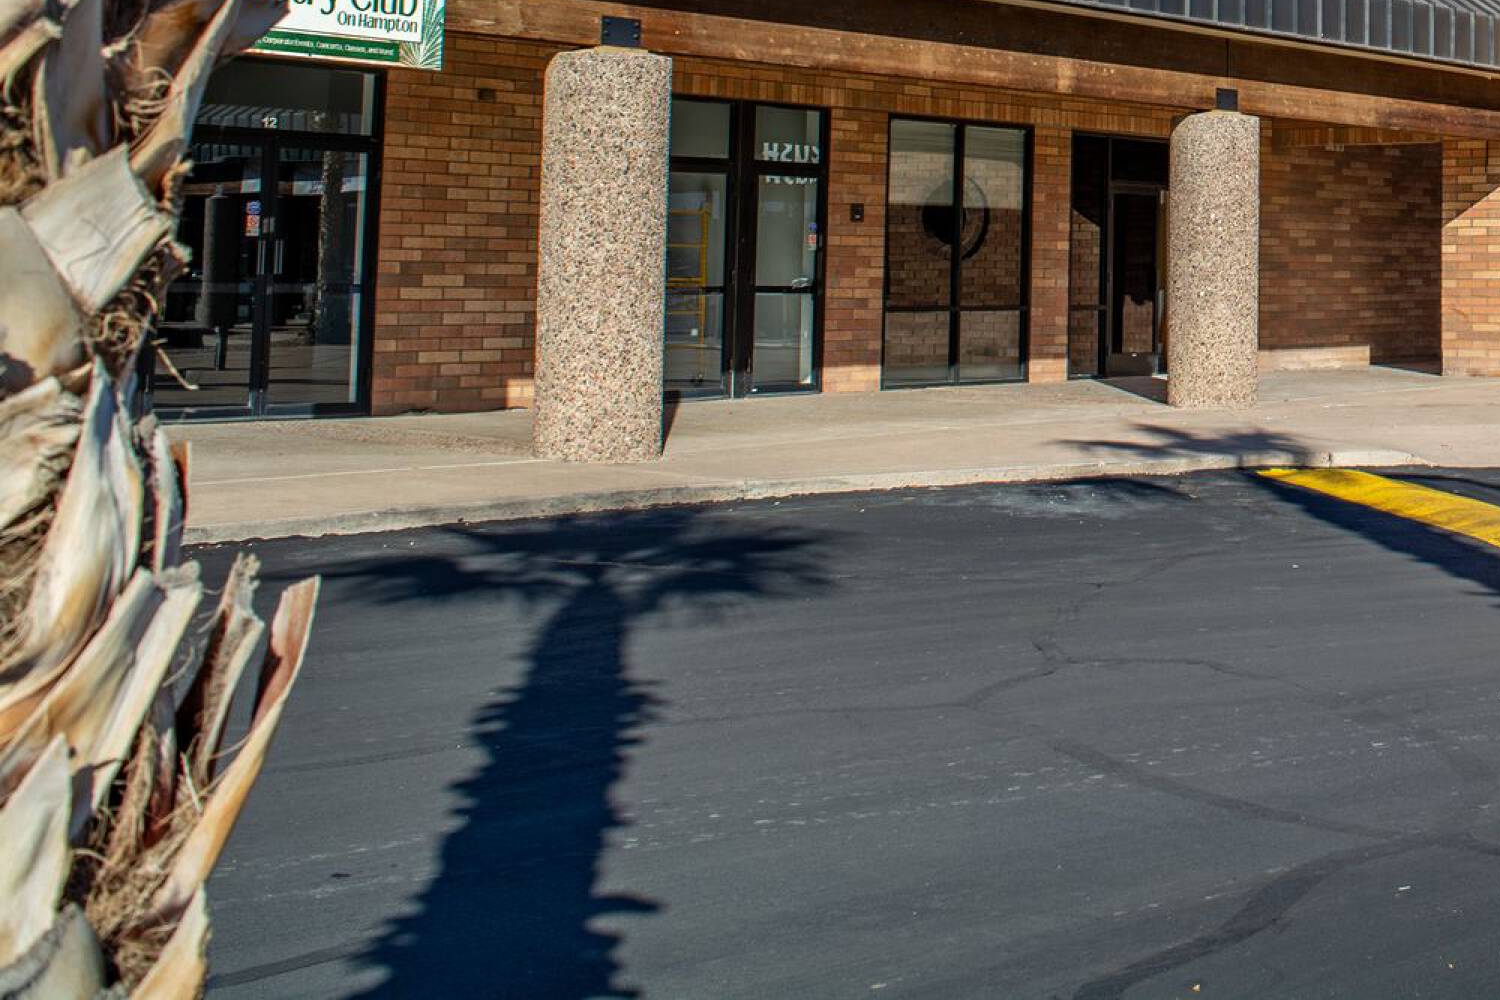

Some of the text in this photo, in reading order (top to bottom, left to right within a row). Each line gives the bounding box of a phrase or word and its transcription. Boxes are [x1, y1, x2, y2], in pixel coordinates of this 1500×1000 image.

[337, 10, 418, 34] On Hampton
[261, 117, 278, 129] 12
